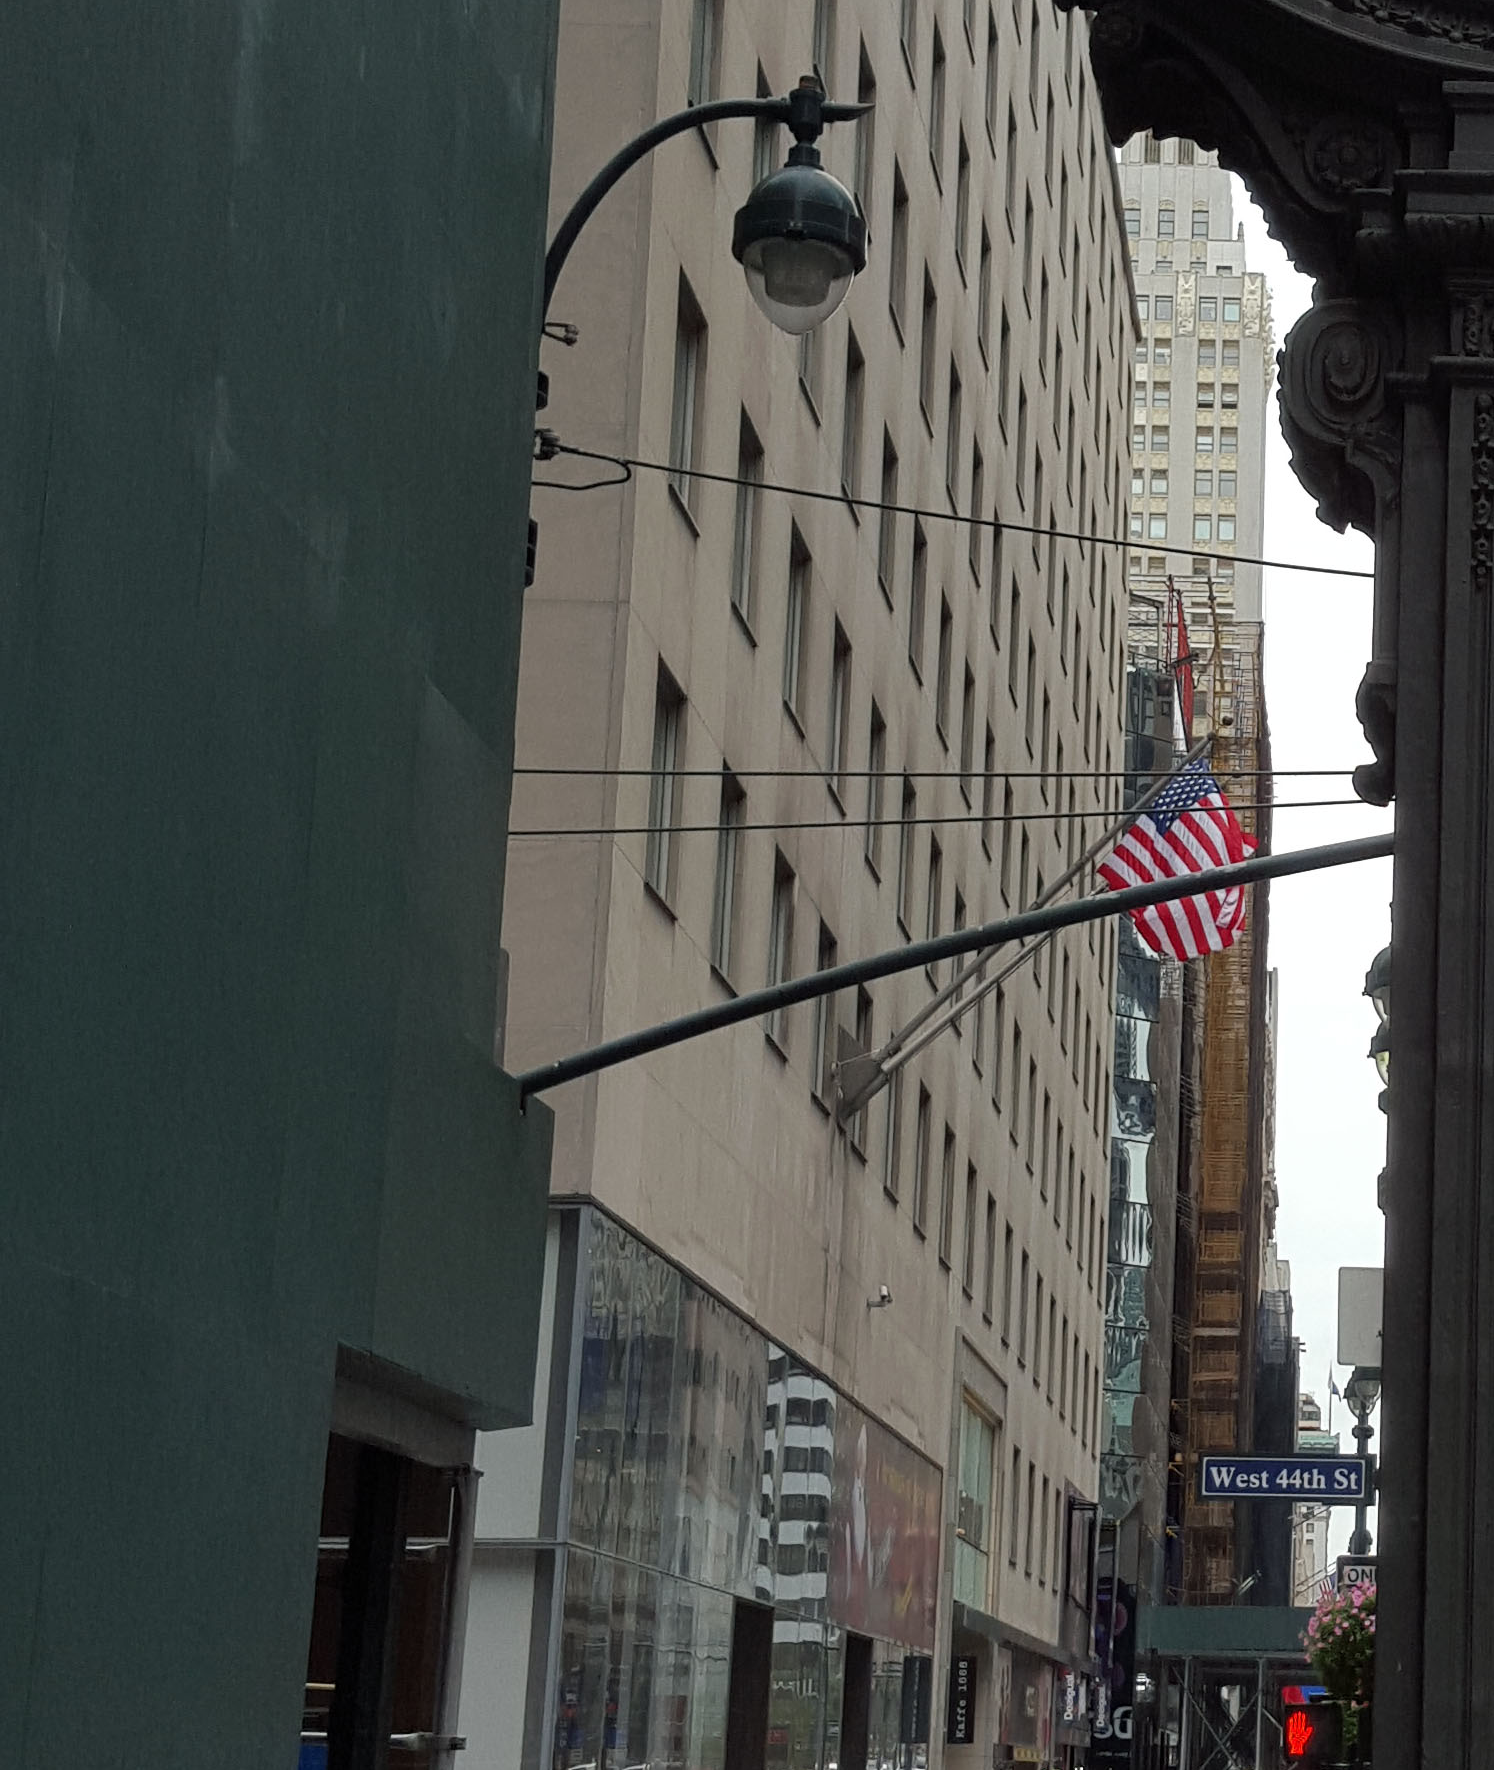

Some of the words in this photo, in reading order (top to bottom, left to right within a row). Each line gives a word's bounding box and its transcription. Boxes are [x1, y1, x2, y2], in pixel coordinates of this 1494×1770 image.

[1210, 1466, 1269, 1489] West
[1275, 1467, 1327, 1490] 44th
[1333, 1468, 1358, 1490] St
[1347, 1568, 1377, 1583] ON
[1064, 1672, 1076, 1721] Desigual
[955, 1700, 967, 1738] Kaffe
